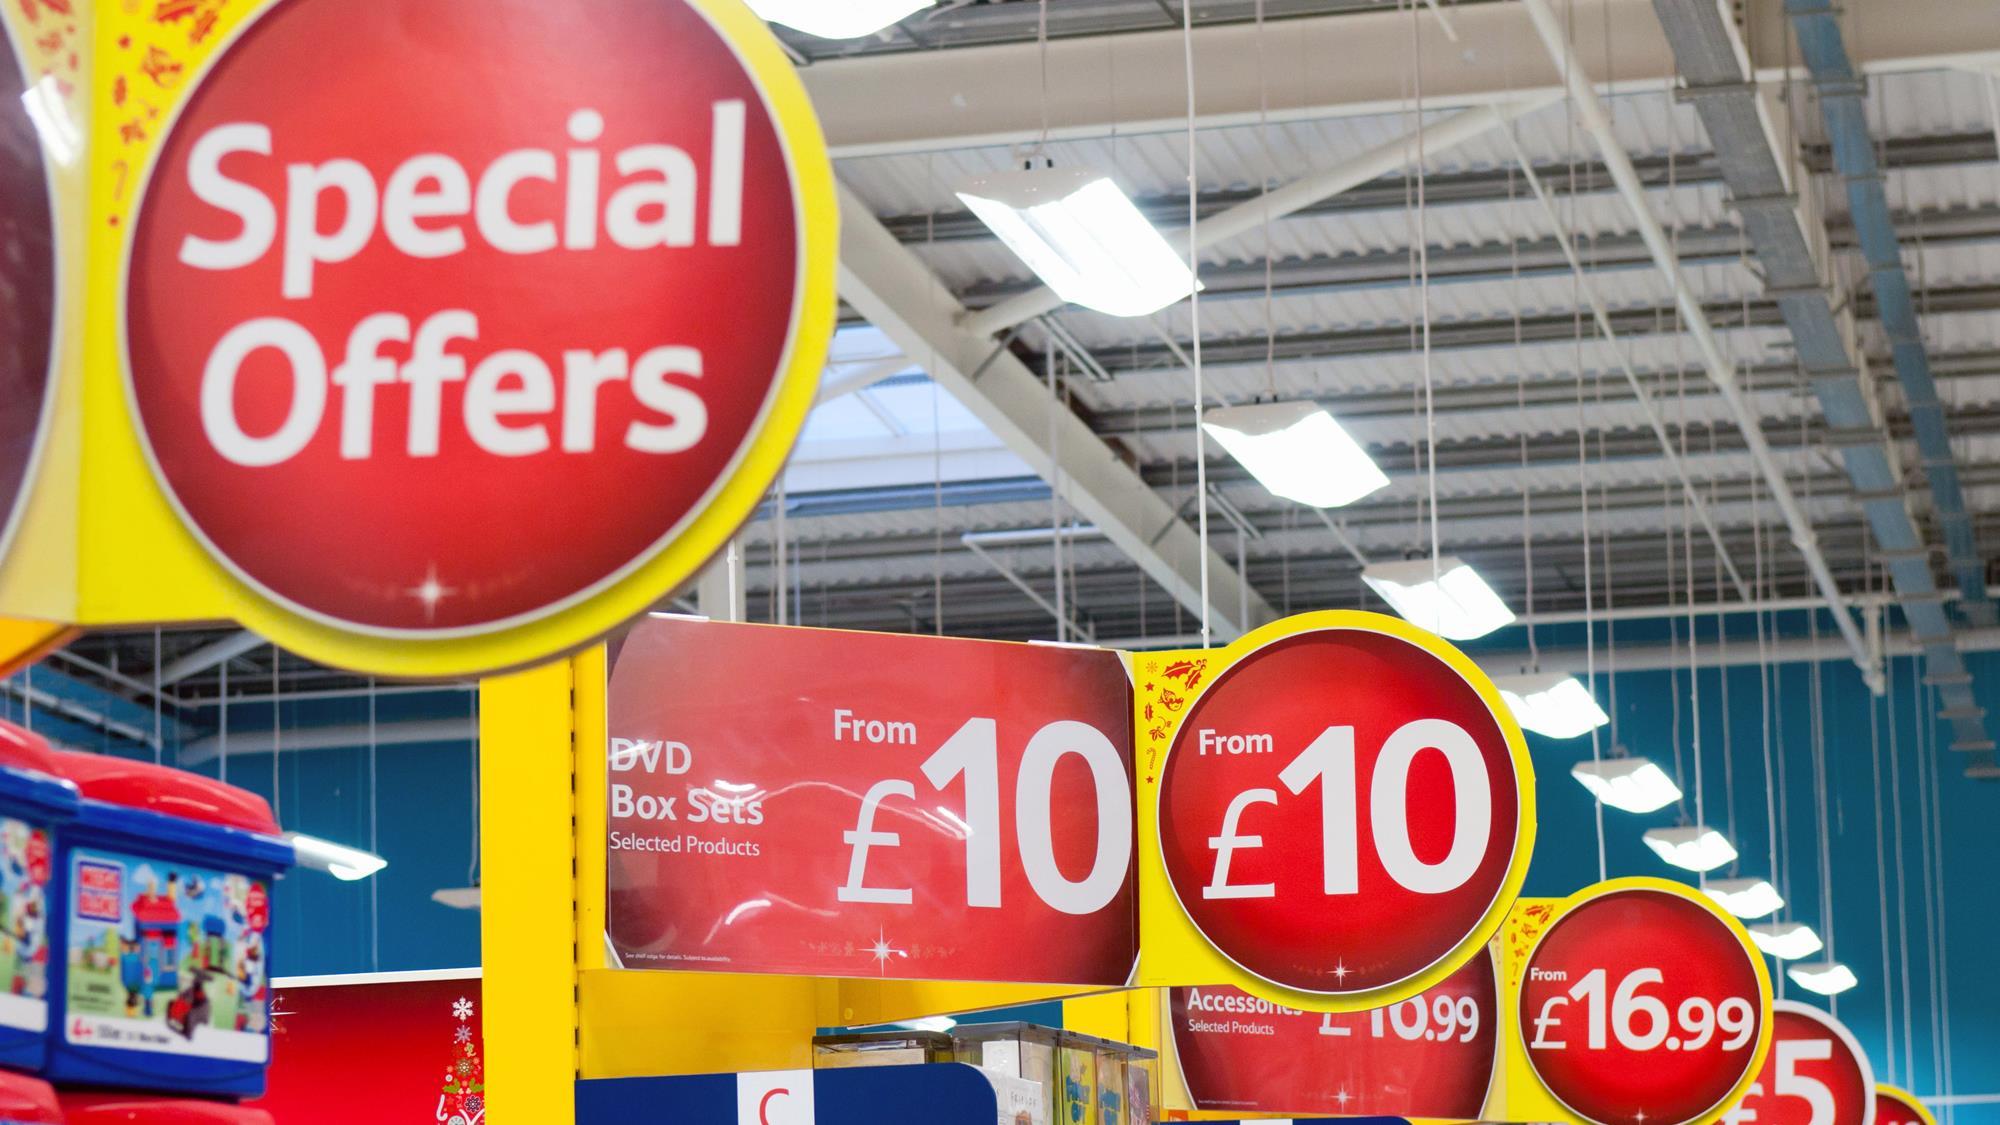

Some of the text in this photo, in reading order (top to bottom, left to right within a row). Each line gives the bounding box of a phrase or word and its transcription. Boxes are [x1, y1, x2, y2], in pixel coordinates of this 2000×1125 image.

[179, 99, 746, 299] Special
[201, 309, 708, 467] Offers
[833, 709, 917, 745] From
[1199, 728, 1273, 756] From
[609, 737, 692, 775] DVD
[610, 783, 764, 826] Box Sets
[838, 716, 1132, 915] £10
[1202, 717, 1492, 900] £10
[610, 831, 761, 858] Selected Products
[1529, 966, 1567, 982] From
[1188, 1019, 1275, 1036] Selected Products
[1530, 967, 1755, 1052] £16.99
